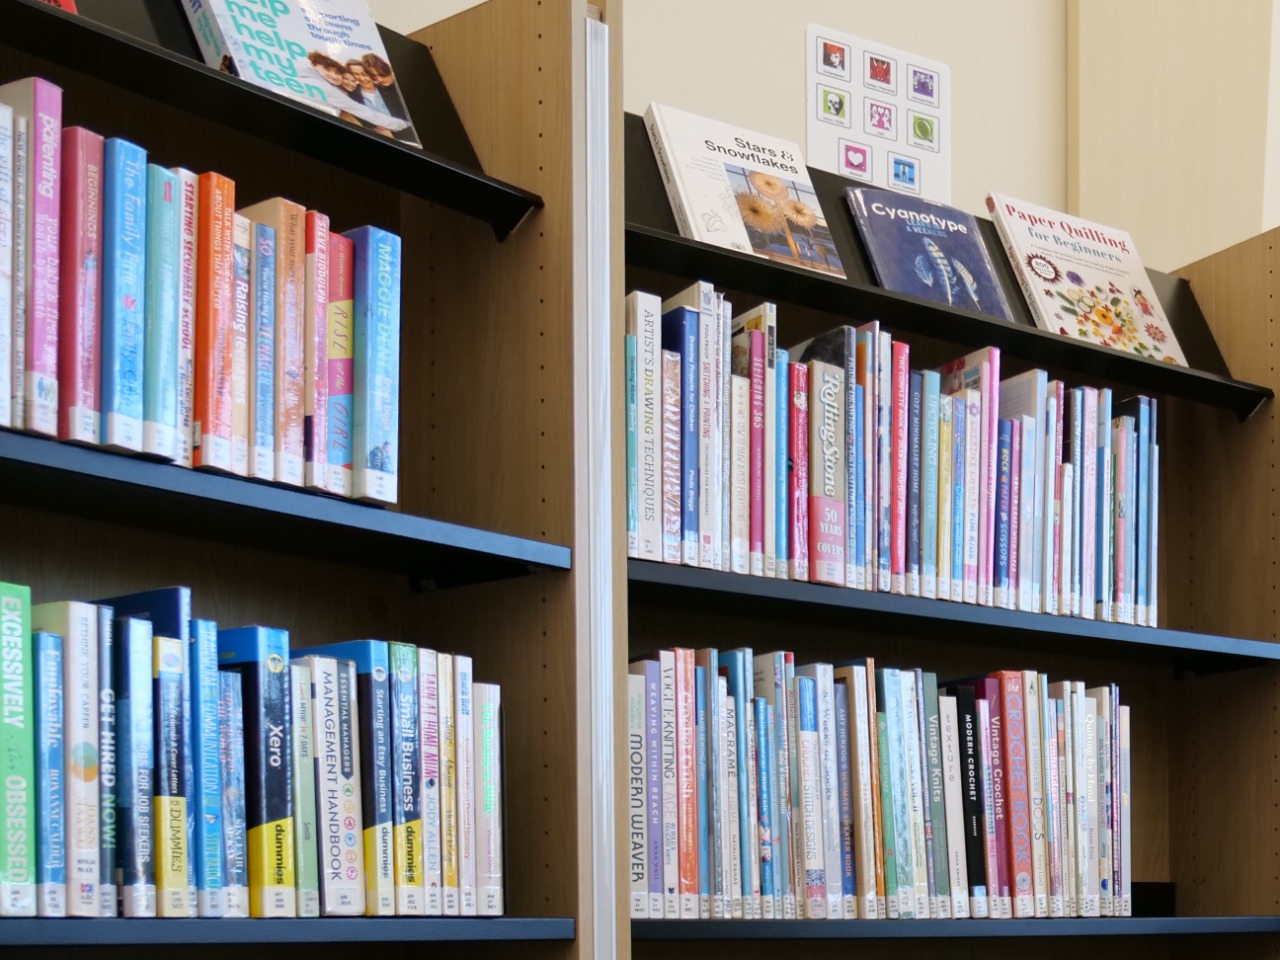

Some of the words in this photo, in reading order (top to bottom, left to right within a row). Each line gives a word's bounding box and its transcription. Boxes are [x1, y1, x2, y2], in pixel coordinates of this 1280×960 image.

[228, 1, 277, 28] me
[231, 15, 307, 60] help
[243, 41, 298, 78] my
[249, 61, 327, 101] teen
[704, 139, 799, 174] Snowflakes
[733, 135, 774, 160] Stars
[780, 147, 794, 163] &
[870, 201, 969, 234] Cyanotype
[1005, 203, 1055, 231] Paper
[1057, 219, 1129, 252] Quilling
[1027, 228, 1047, 242] for
[1051, 234, 1123, 263] Beginners
[234, 281, 248, 330] Raising
[332, 306, 347, 354] RISE
[644, 310, 654, 369] ARTIST'S
[234, 336, 246, 404] teenagers
[644, 372, 654, 433] DRAWING
[331, 401, 348, 456] GIRL
[644, 437, 655, 521] TECHNIQUES
[1, 596, 24, 729] EXCESSIVELY
[1007, 680, 1019, 691] the
[102, 689, 115, 727] GET
[323, 671, 337, 785] MANAGEMENT
[400, 694, 412, 739] Small
[269, 723, 283, 767] Xero
[929, 715, 938, 764] Vintage
[965, 714, 974, 755] MODERN
[991, 716, 1000, 765] Vintage
[1007, 694, 1024, 789] CROCHET
[102, 732, 115, 787] HIRED
[402, 742, 413, 812] Business
[630, 733, 643, 808] MODERN
[932, 766, 942, 802] Knits
[967, 758, 976, 801] CROCHET
[993, 768, 1003, 819] Crochet
[5, 775, 26, 882] OBSESSED
[102, 793, 116, 849] NOW!
[328, 789, 342, 880] HANDBOOK
[1011, 801, 1029, 864] BOOK
[275, 824, 284, 885] dummies
[406, 825, 415, 883] dummies
[631, 812, 644, 883] WEAVER
